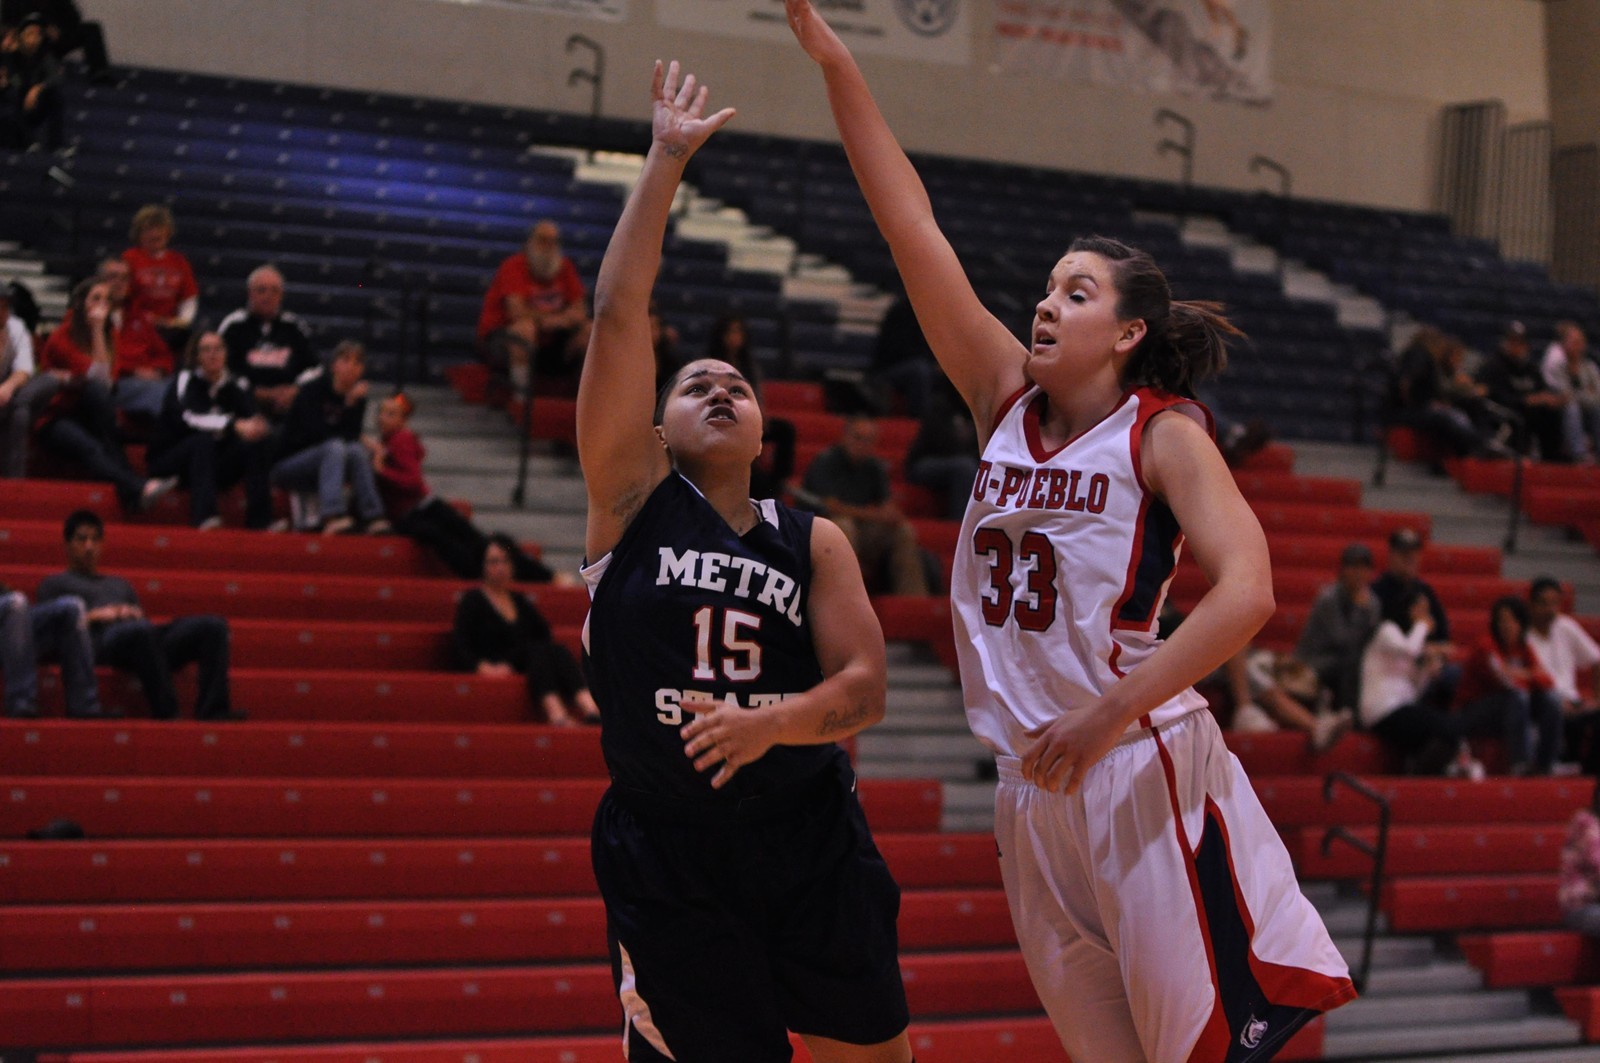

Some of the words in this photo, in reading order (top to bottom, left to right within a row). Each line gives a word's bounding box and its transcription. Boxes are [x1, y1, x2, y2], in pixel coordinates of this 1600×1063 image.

[973, 528, 1058, 631] 33
[693, 605, 762, 681] 15
[655, 688, 805, 726] STT
